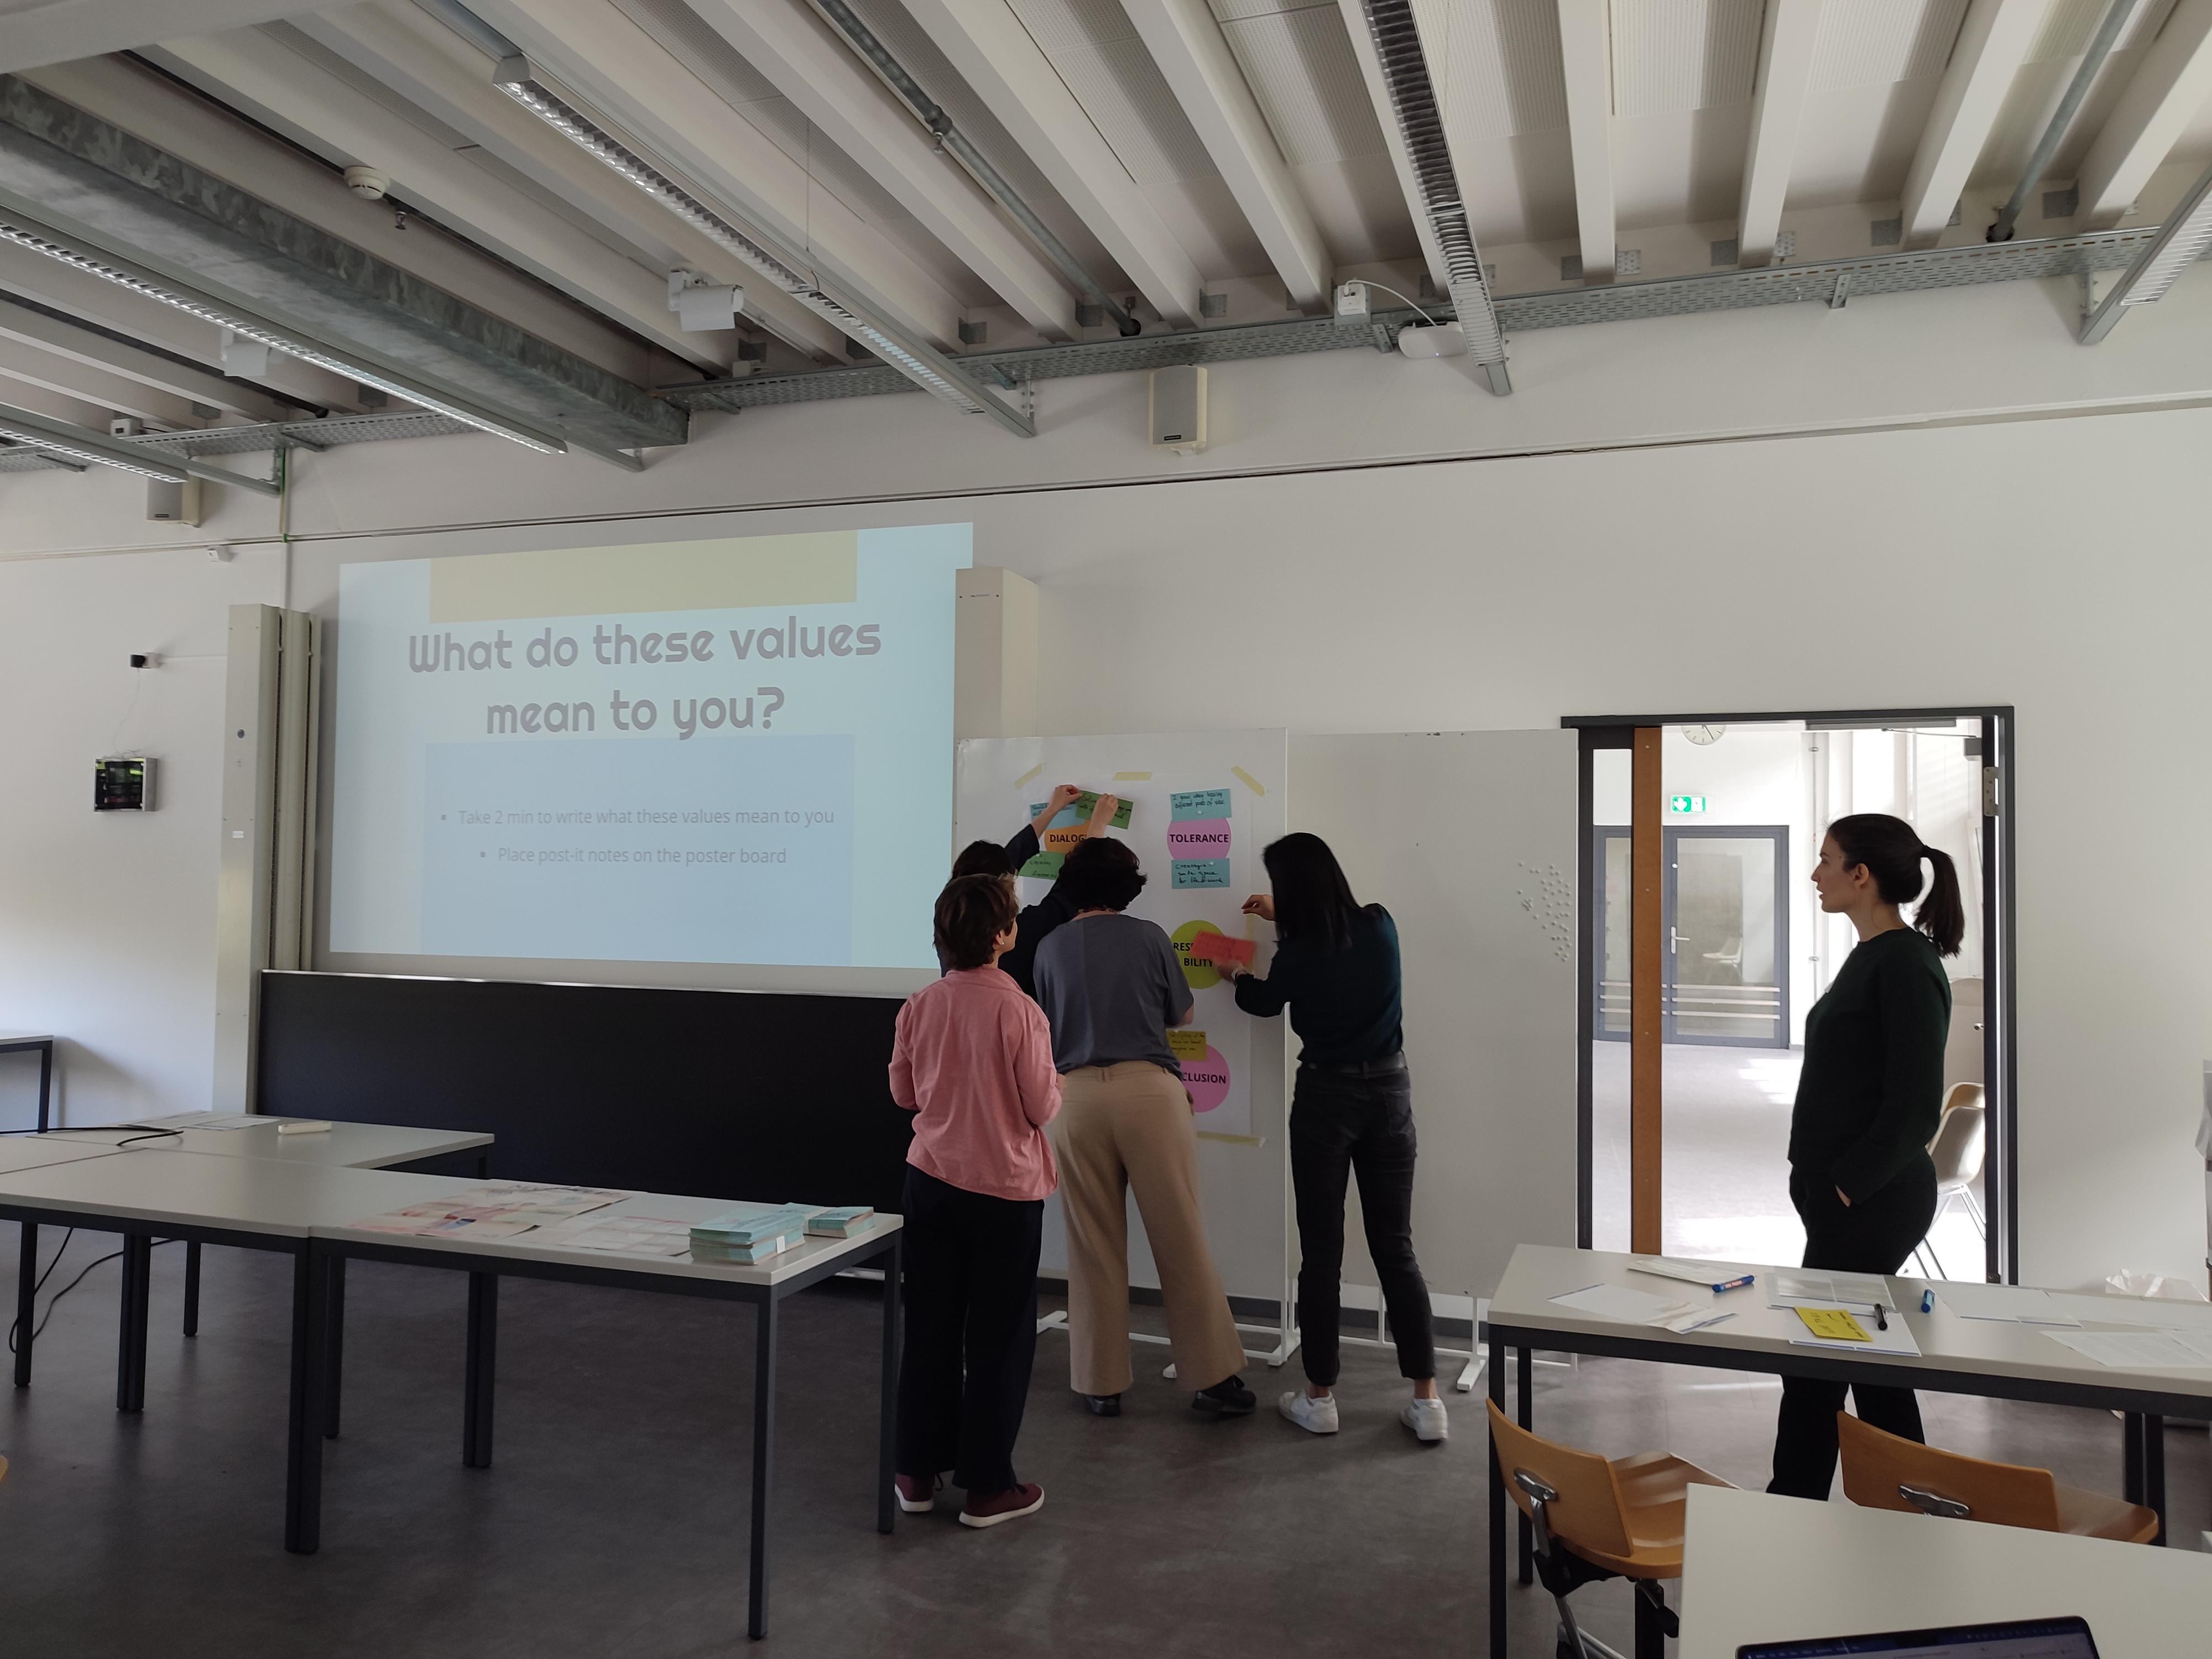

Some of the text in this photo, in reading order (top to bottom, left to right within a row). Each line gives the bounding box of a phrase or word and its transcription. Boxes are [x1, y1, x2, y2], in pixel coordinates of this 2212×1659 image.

[409, 615, 882, 673] What do these values
[487, 686, 785, 740] mean to you?
[458, 808, 834, 828] Take 2 min to write what these values mean to you
[1050, 834, 1087, 843] DIALOG
[1169, 834, 1229, 843] TOLERANCE
[498, 847, 787, 867] Place post-it notes on the poster board
[1173, 942, 1193, 952] RES
[1183, 1072, 1226, 1084] CLUSION
